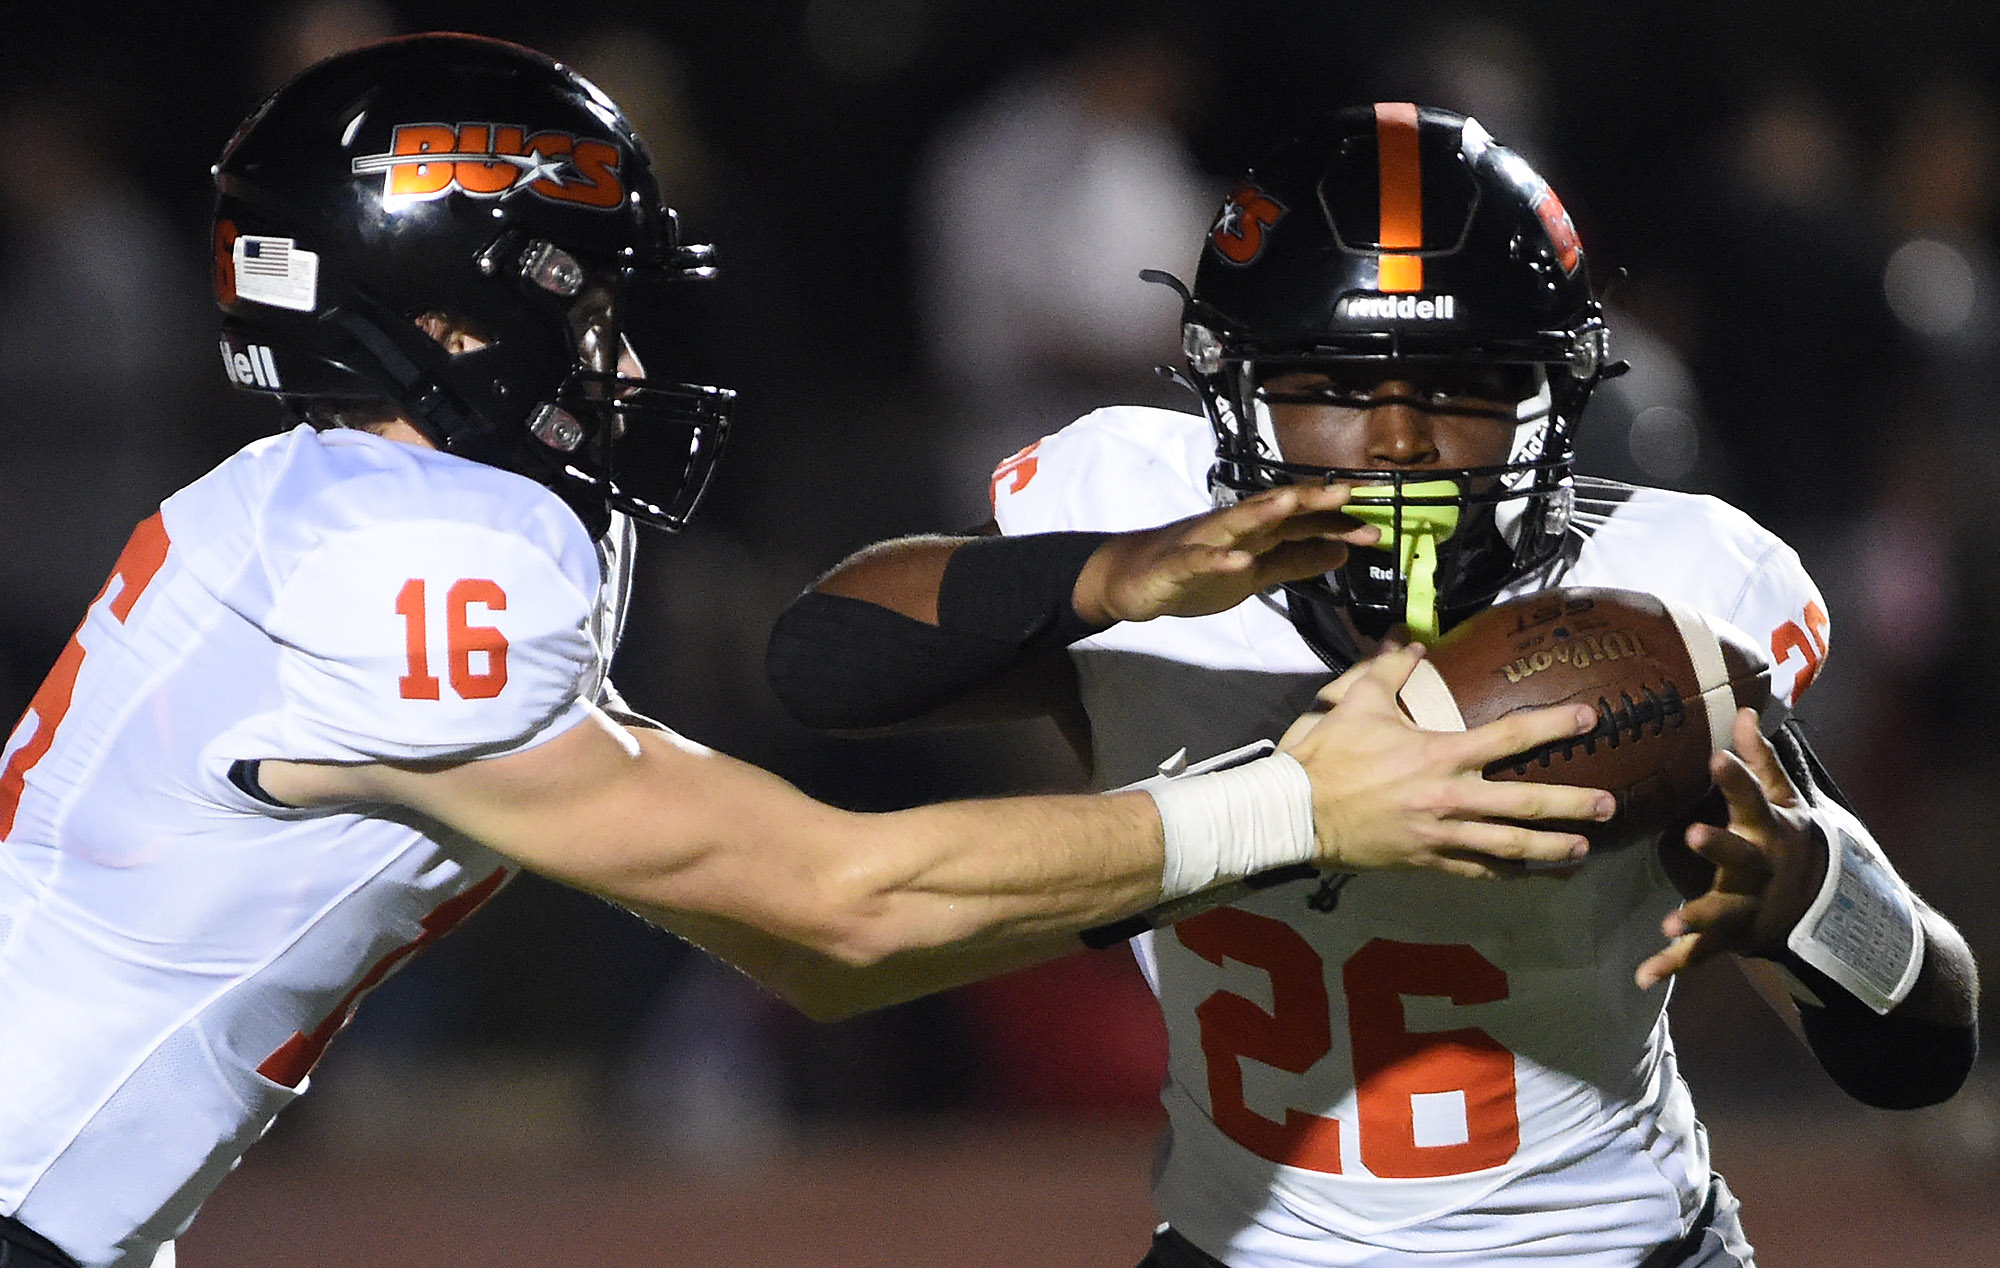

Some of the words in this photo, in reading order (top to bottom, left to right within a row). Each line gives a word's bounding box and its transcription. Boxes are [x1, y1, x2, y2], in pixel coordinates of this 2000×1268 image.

[382, 121, 625, 212] BUCS
[395, 577, 508, 701] 16
[1500, 629, 1649, 684] Wilson
[1174, 905, 1520, 1178] 26
